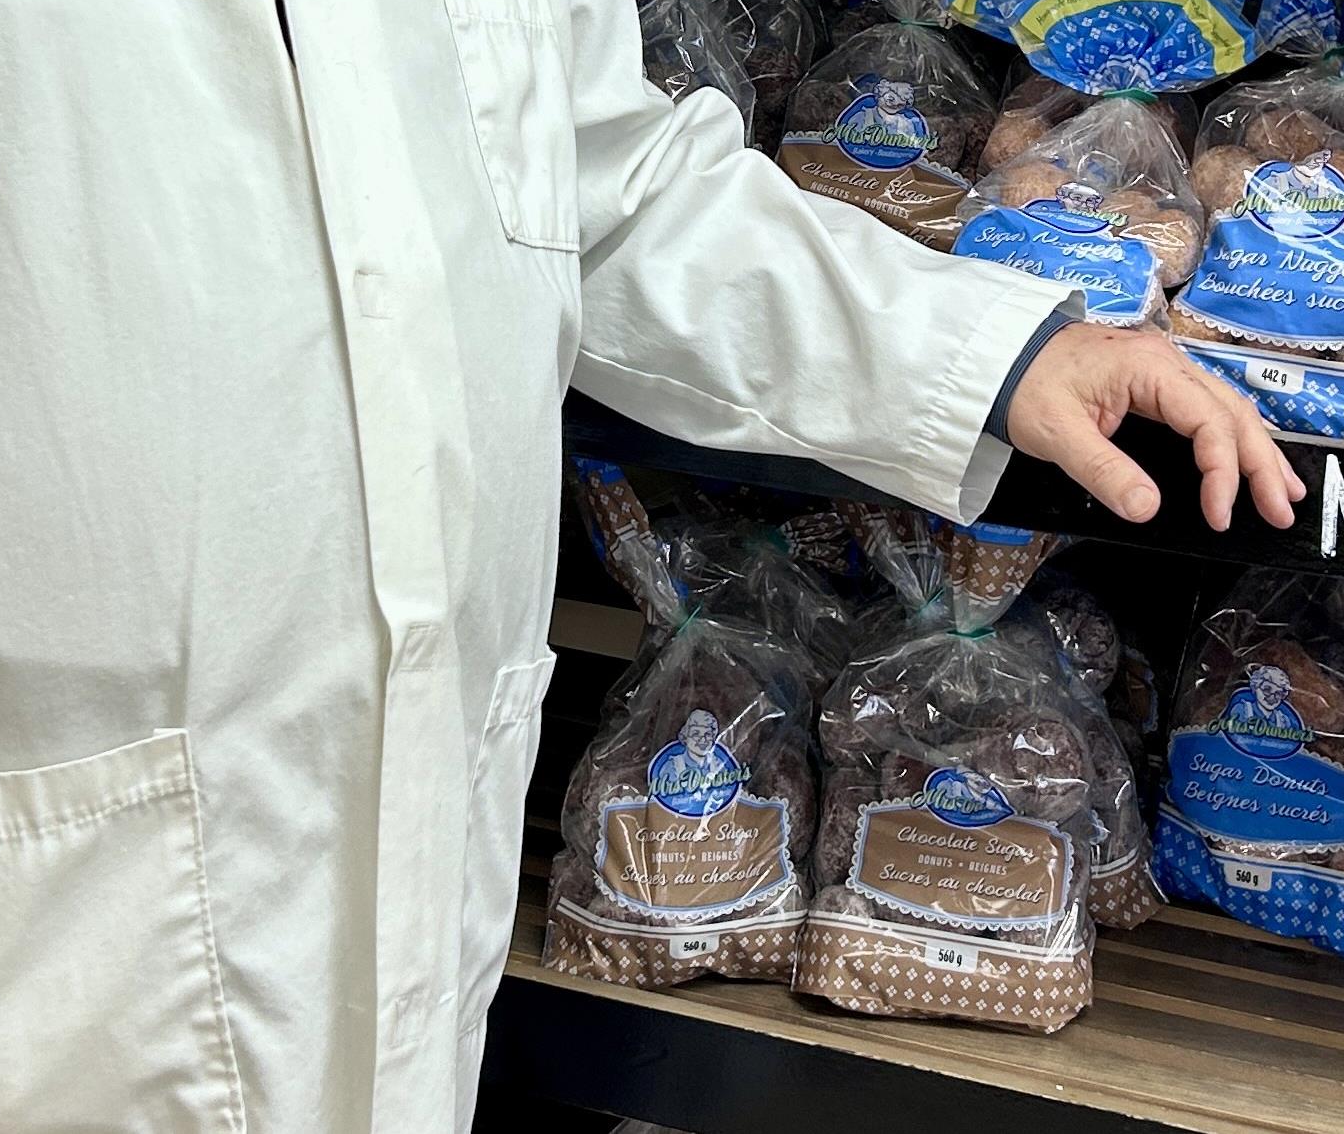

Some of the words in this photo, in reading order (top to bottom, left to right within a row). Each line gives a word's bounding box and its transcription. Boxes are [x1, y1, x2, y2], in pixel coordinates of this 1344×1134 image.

[800, 160, 881, 191] Chocolate
[884, 177, 935, 206] Sugar
[810, 180, 850, 201] NUGGETS
[974, 226, 1026, 249] Sugar
[1053, 265, 1123, 296] sucrés
[1197, 271, 1298, 305] Bouchées
[1260, 366, 1279, 383] 442
[1280, 372, 1288, 387] g
[1187, 752, 1245, 783] Sugar
[1251, 764, 1330, 797] Donuts
[1182, 779, 1262, 814] Beignes
[1266, 801, 1333, 826] sucrés
[715, 822, 760, 846] Sugar
[896, 825, 979, 852] Chocolate
[984, 837, 1036, 862] Sugar
[700, 849, 740, 863] BEIGNES
[917, 853, 954, 868] DONUTS
[967, 860, 1009, 877] BEIGNES
[674, 871, 696, 885] au
[878, 863, 933, 888] Sucrés
[937, 875, 961, 893] au
[964, 876, 1045, 904] chocolat
[1235, 869, 1253, 884] 560
[1252, 874, 1260, 887] g
[683, 940, 701, 952] 560
[937, 948, 956, 965] 560
[956, 952, 963, 967] g
